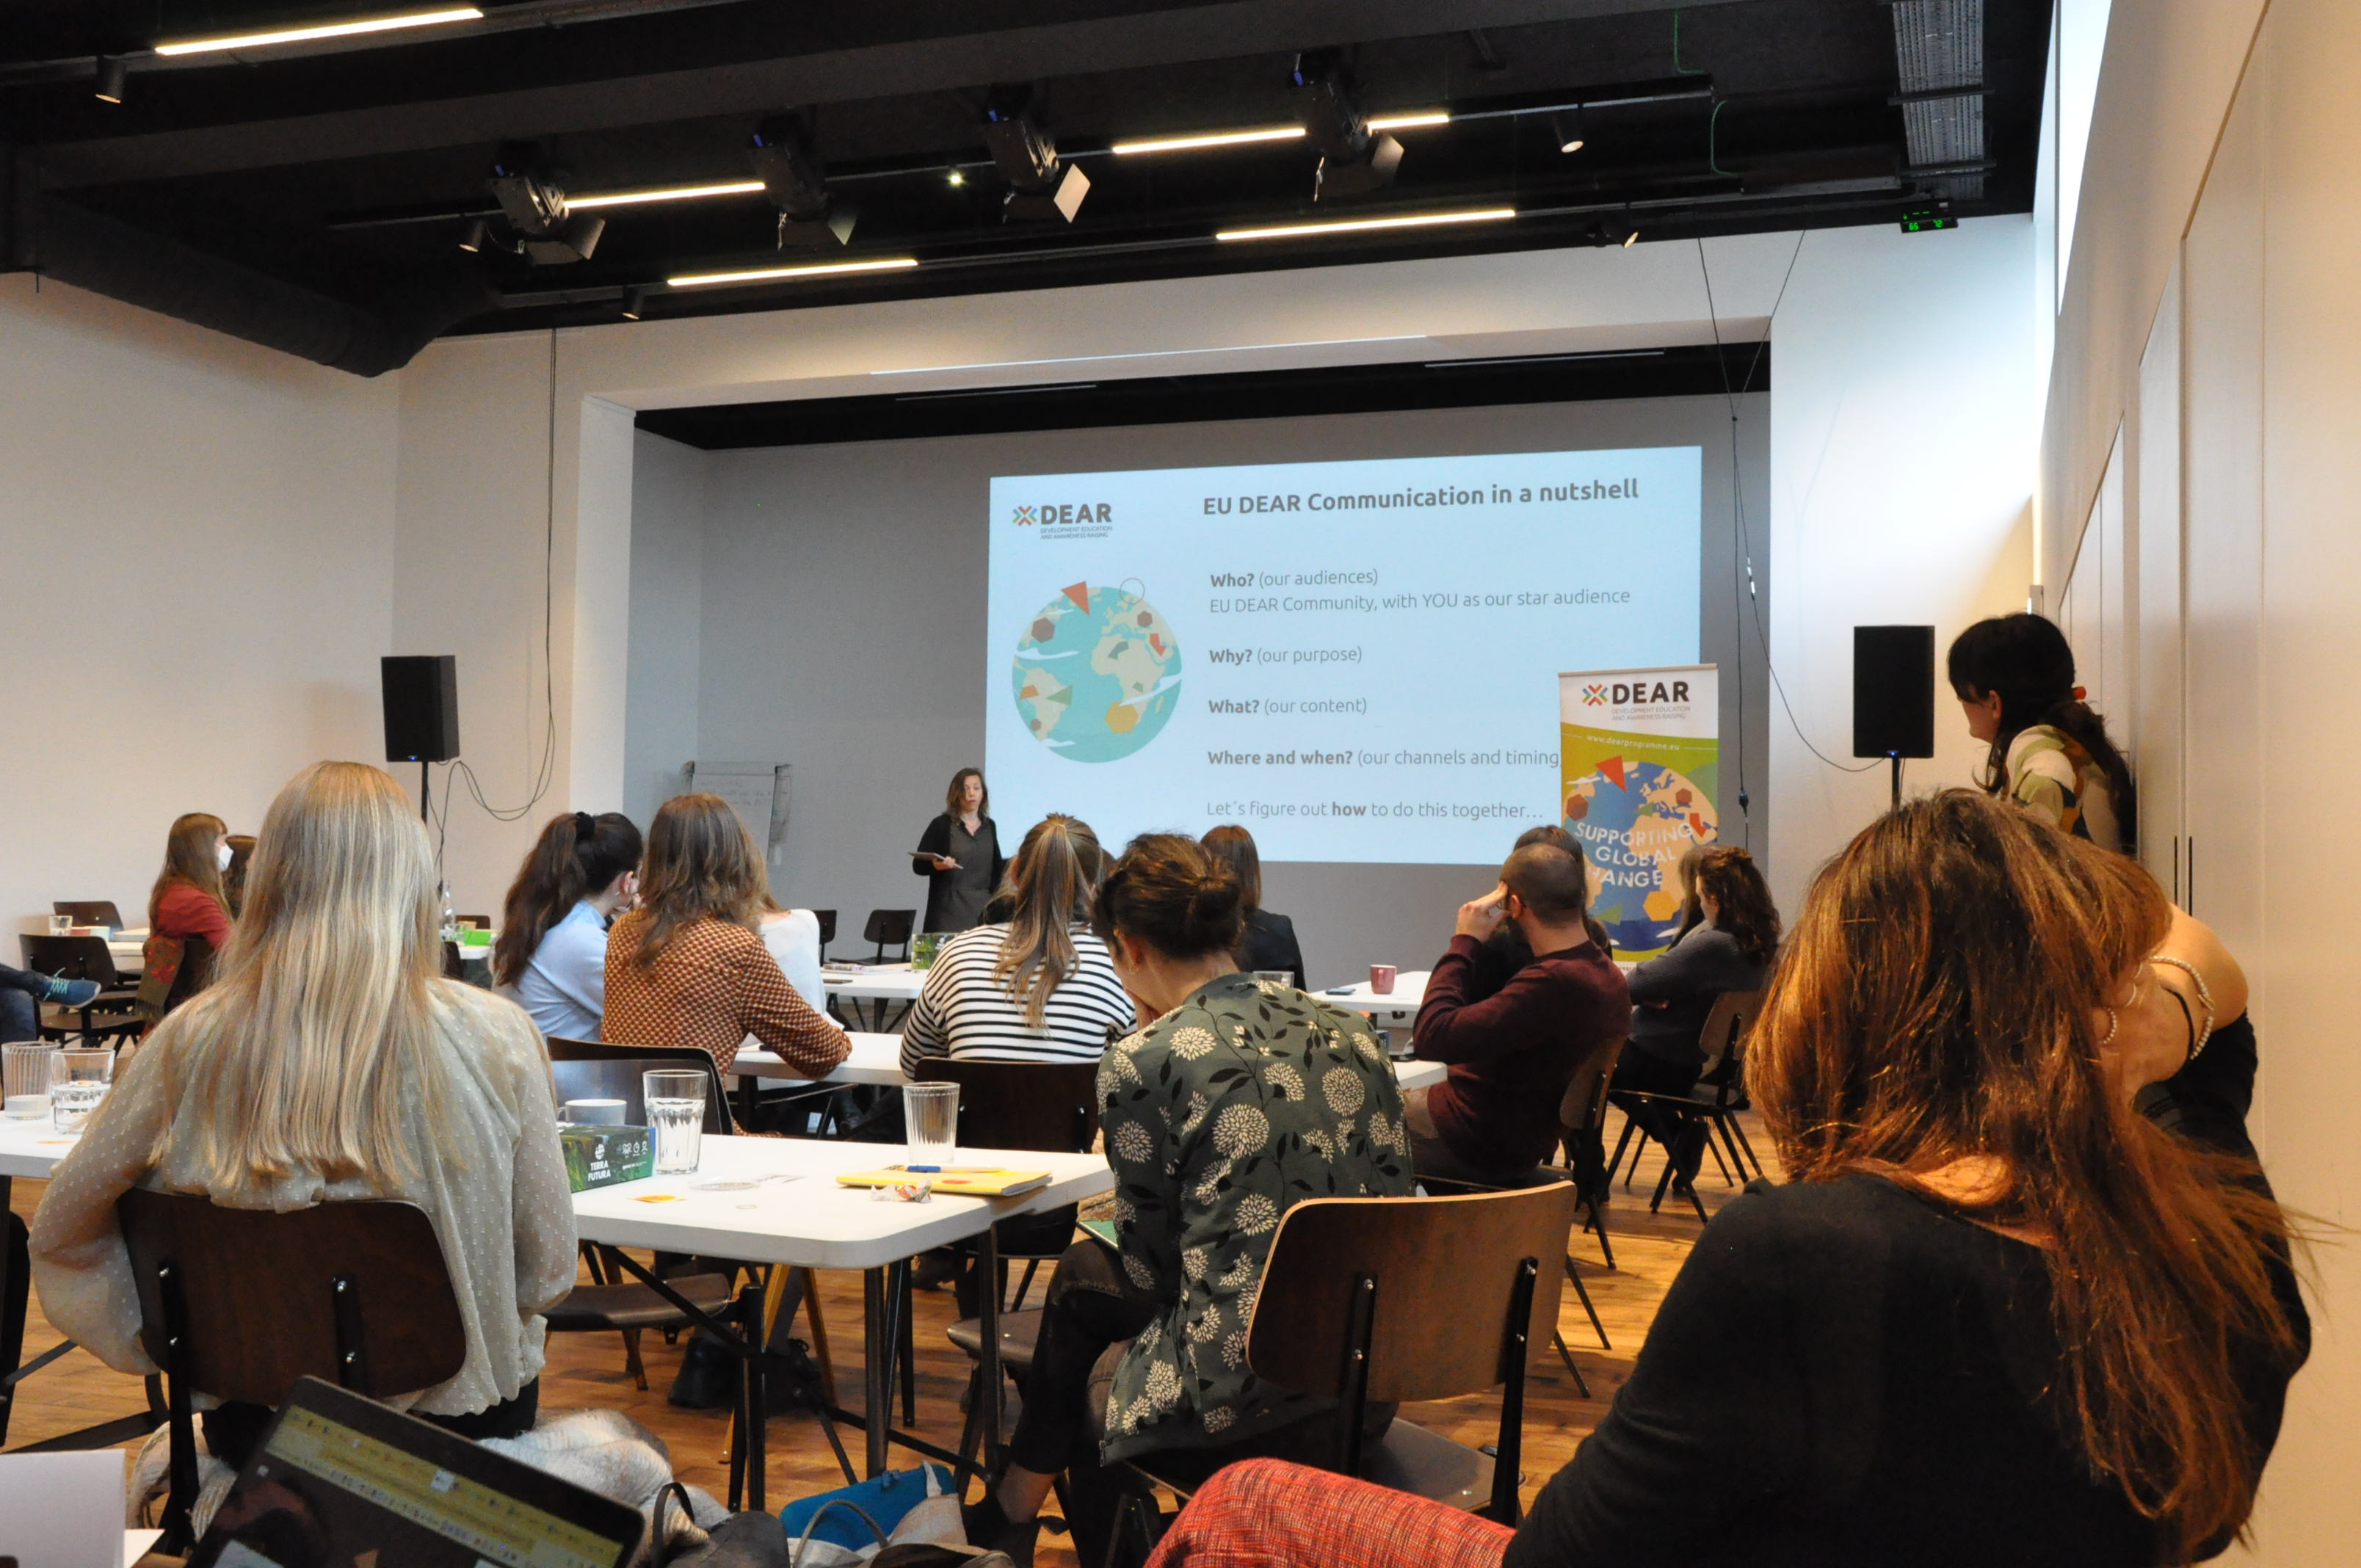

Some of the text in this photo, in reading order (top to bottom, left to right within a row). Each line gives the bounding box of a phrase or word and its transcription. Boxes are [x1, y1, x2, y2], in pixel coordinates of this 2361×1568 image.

[1203, 478, 1639, 515] EU DEAR Communication in a nutshell
[1040, 503, 1112, 525] DEAR
[1210, 568, 1378, 589] Who? (our audiences)
[1210, 589, 1631, 613] EU DEAR Community, with YOU as our star audience
[1209, 646, 1363, 666] Why? (our purpose)
[1611, 681, 1690, 705] DEAR
[1208, 697, 1367, 716] What? (our content)
[1586, 734, 1680, 750] www.dearprogramme.eu
[1208, 749, 1261, 765] Where
[1265, 749, 1296, 764] and
[1301, 749, 1353, 764] when?
[1357, 749, 1390, 767] (our
[1395, 749, 1467, 765] channels
[1470, 749, 1501, 765] and
[1249, 800, 1296, 819] figure
[1300, 803, 1328, 816] out
[1332, 802, 1367, 816] how
[1371, 803, 1388, 816] to
[1393, 802, 1414, 816] do
[1418, 802, 1448, 817] this
[1575, 821, 1692, 846] SUPPORTING
[1595, 846, 1677, 867] GLOBAL
[588, 1169, 611, 1182] FUTURA
[590, 1160, 609, 1171] TERRA
